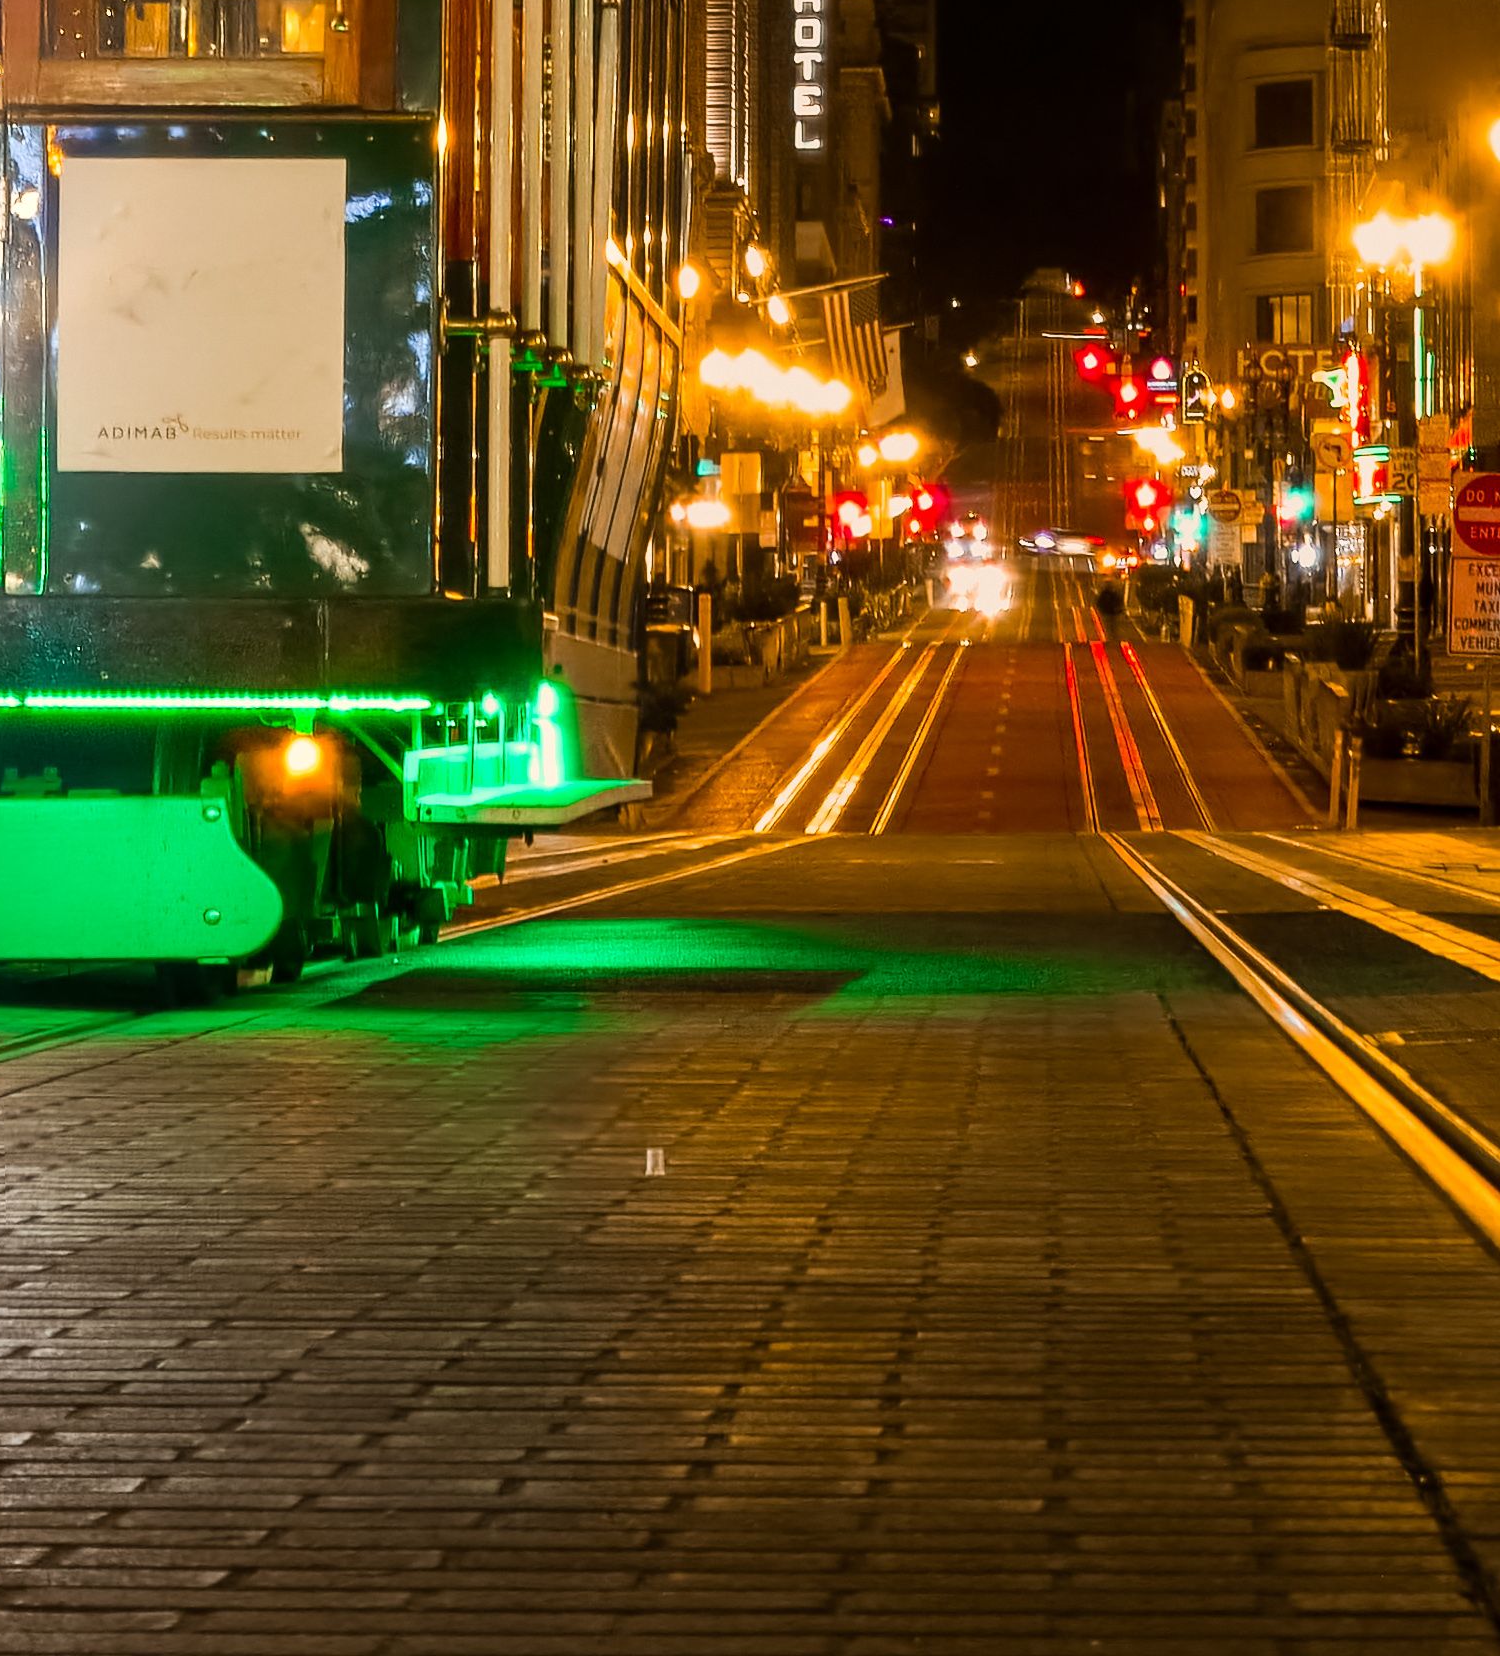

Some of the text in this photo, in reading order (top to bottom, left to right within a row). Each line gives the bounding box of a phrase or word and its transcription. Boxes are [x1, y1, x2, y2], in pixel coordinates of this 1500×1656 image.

[1237, 349, 1335, 377] HOTE
[97, 426, 177, 440] ADIMAB
[192, 427, 246, 440] Results
[1466, 489, 1485, 503] DO
[1470, 526, 1500, 539] ENT
[1469, 562, 1500, 577] EXCE
[1474, 599, 1500, 613] TAXI
[1454, 617, 1500, 631] COMMER
